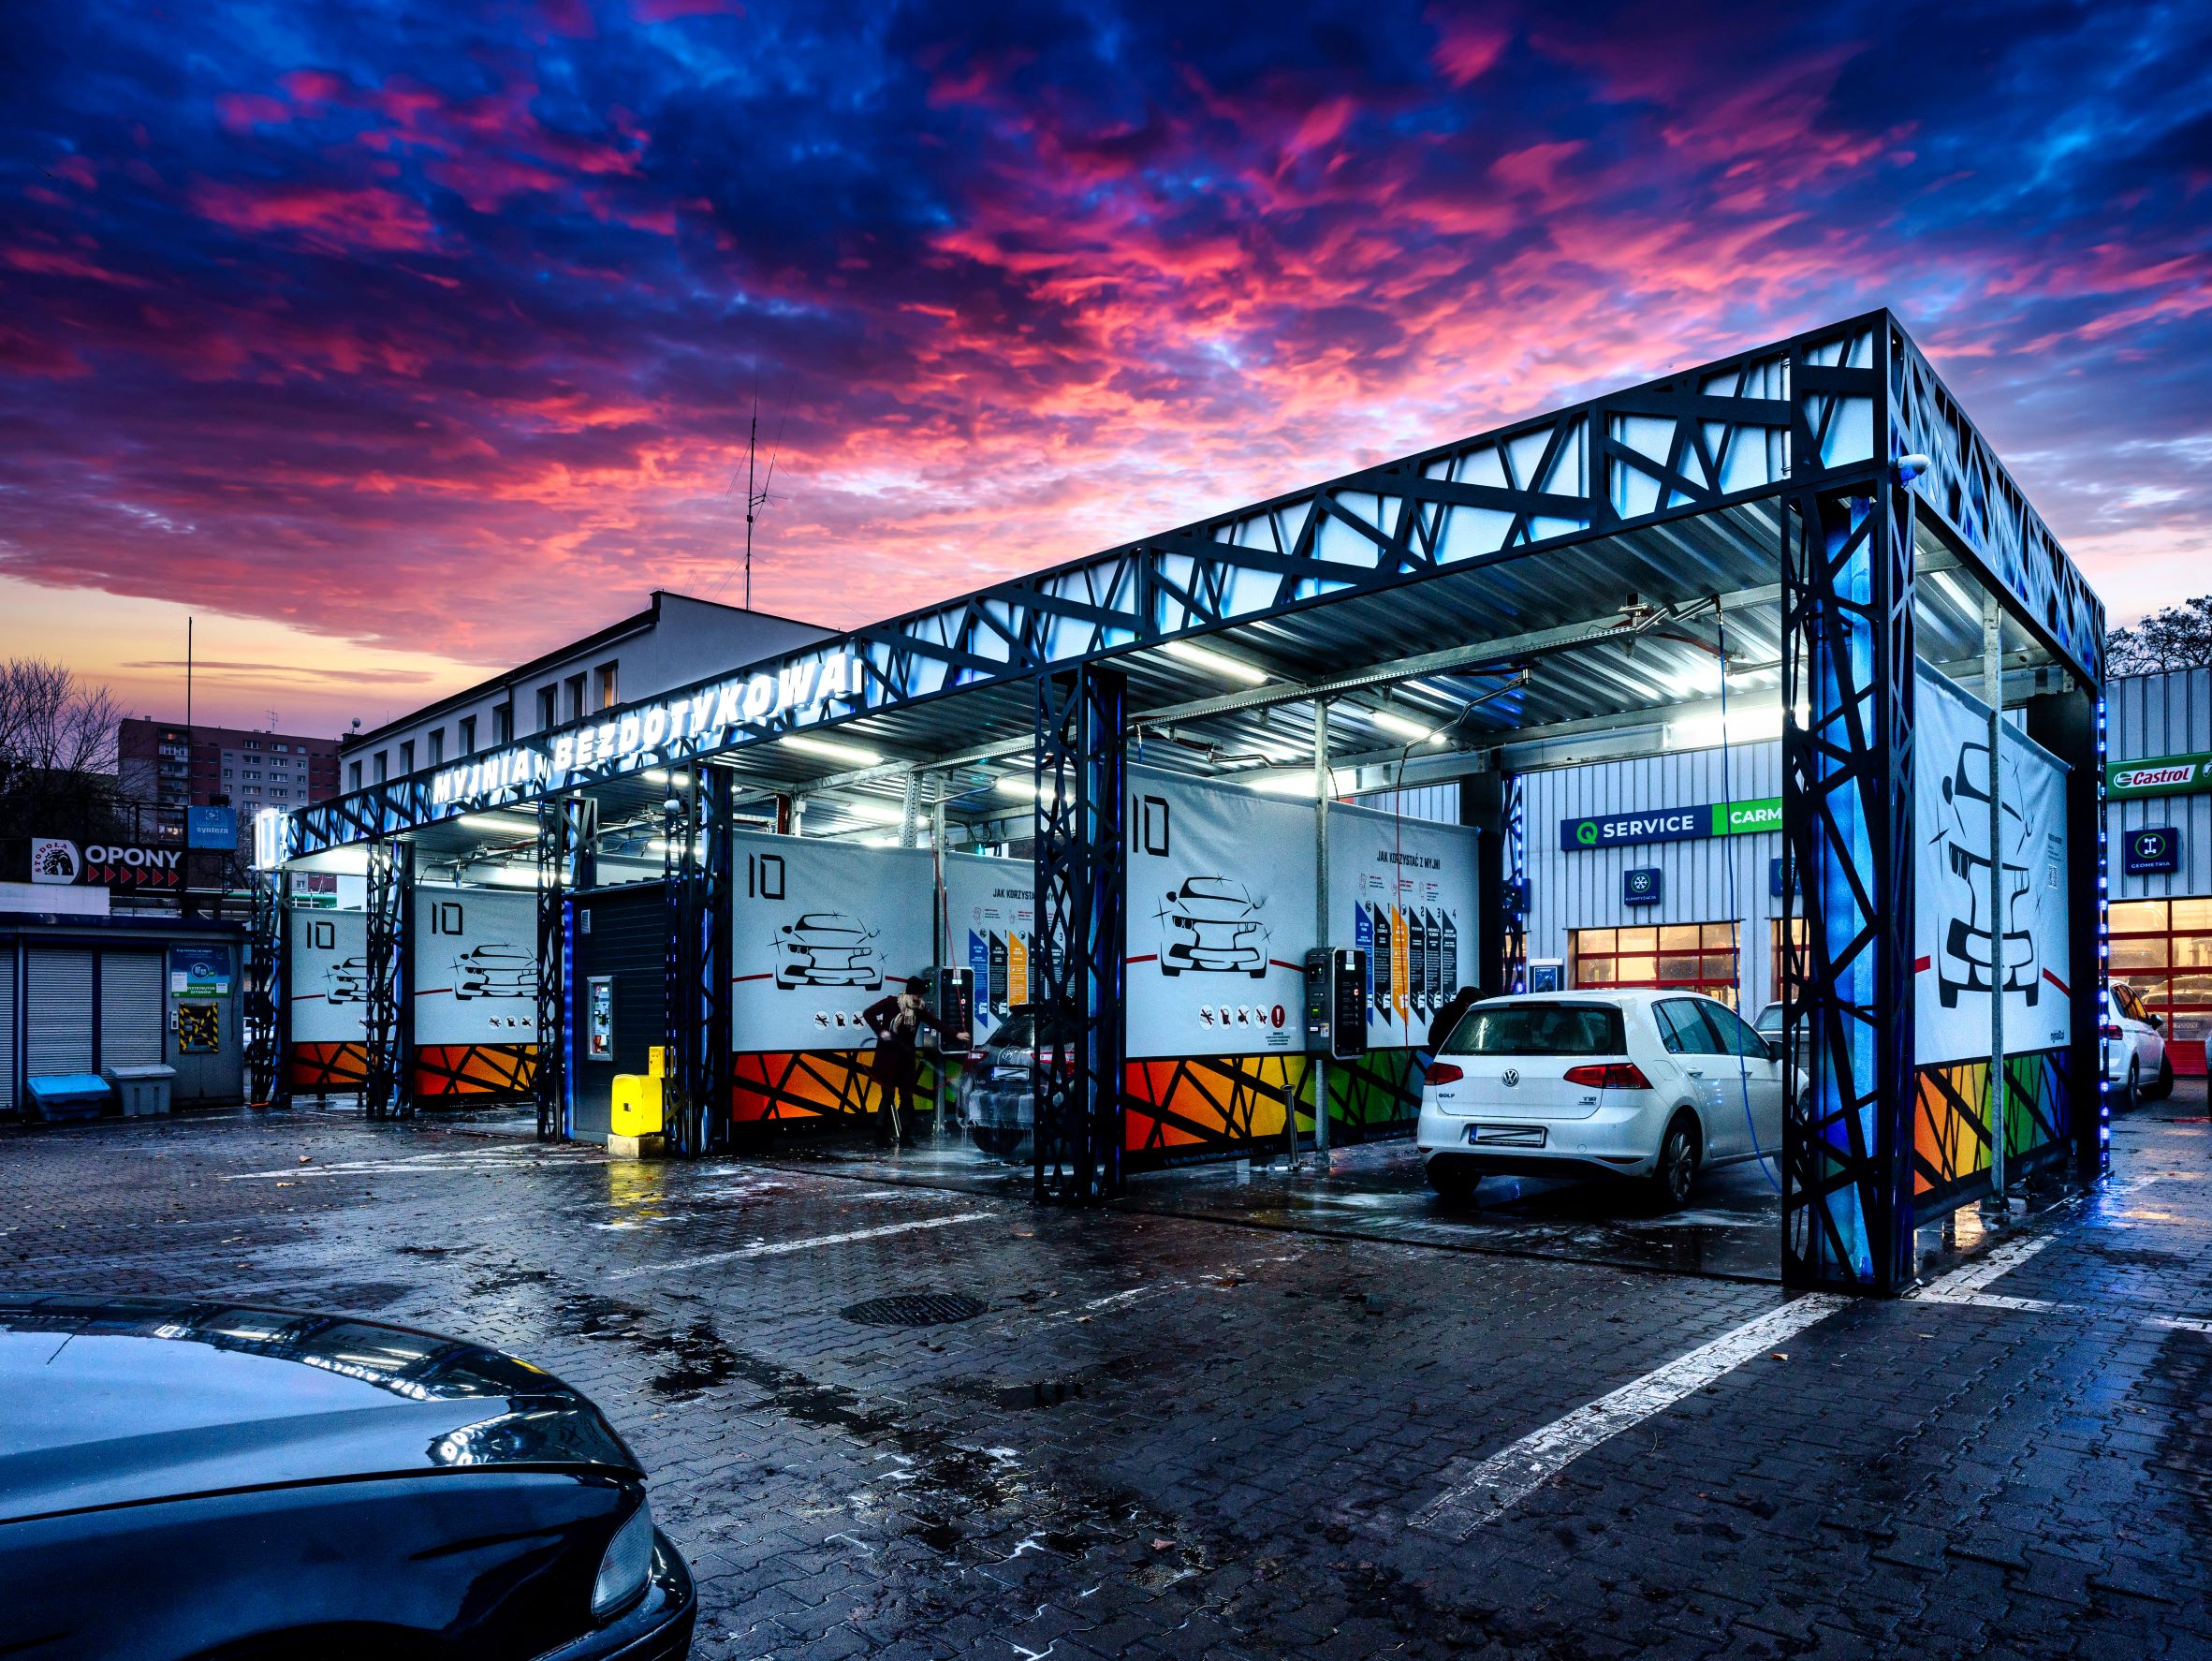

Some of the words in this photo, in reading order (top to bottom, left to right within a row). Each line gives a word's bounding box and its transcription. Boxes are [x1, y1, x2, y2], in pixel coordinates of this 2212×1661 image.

[433, 749, 535, 804] MYJNIA
[554, 653, 853, 772] BEZDOTYKOWA
[2132, 768, 2190, 786] Castrol
[1603, 815, 1694, 838] SERVICE
[1731, 807, 1782, 824] CARM
[85, 845, 182, 869] OPONY
[1376, 850, 1388, 863] JAK
[1425, 857, 1441, 870] MYJNI
[2131, 860, 2170, 869] GEOMETRIA
[992, 889, 1005, 898] JAK
